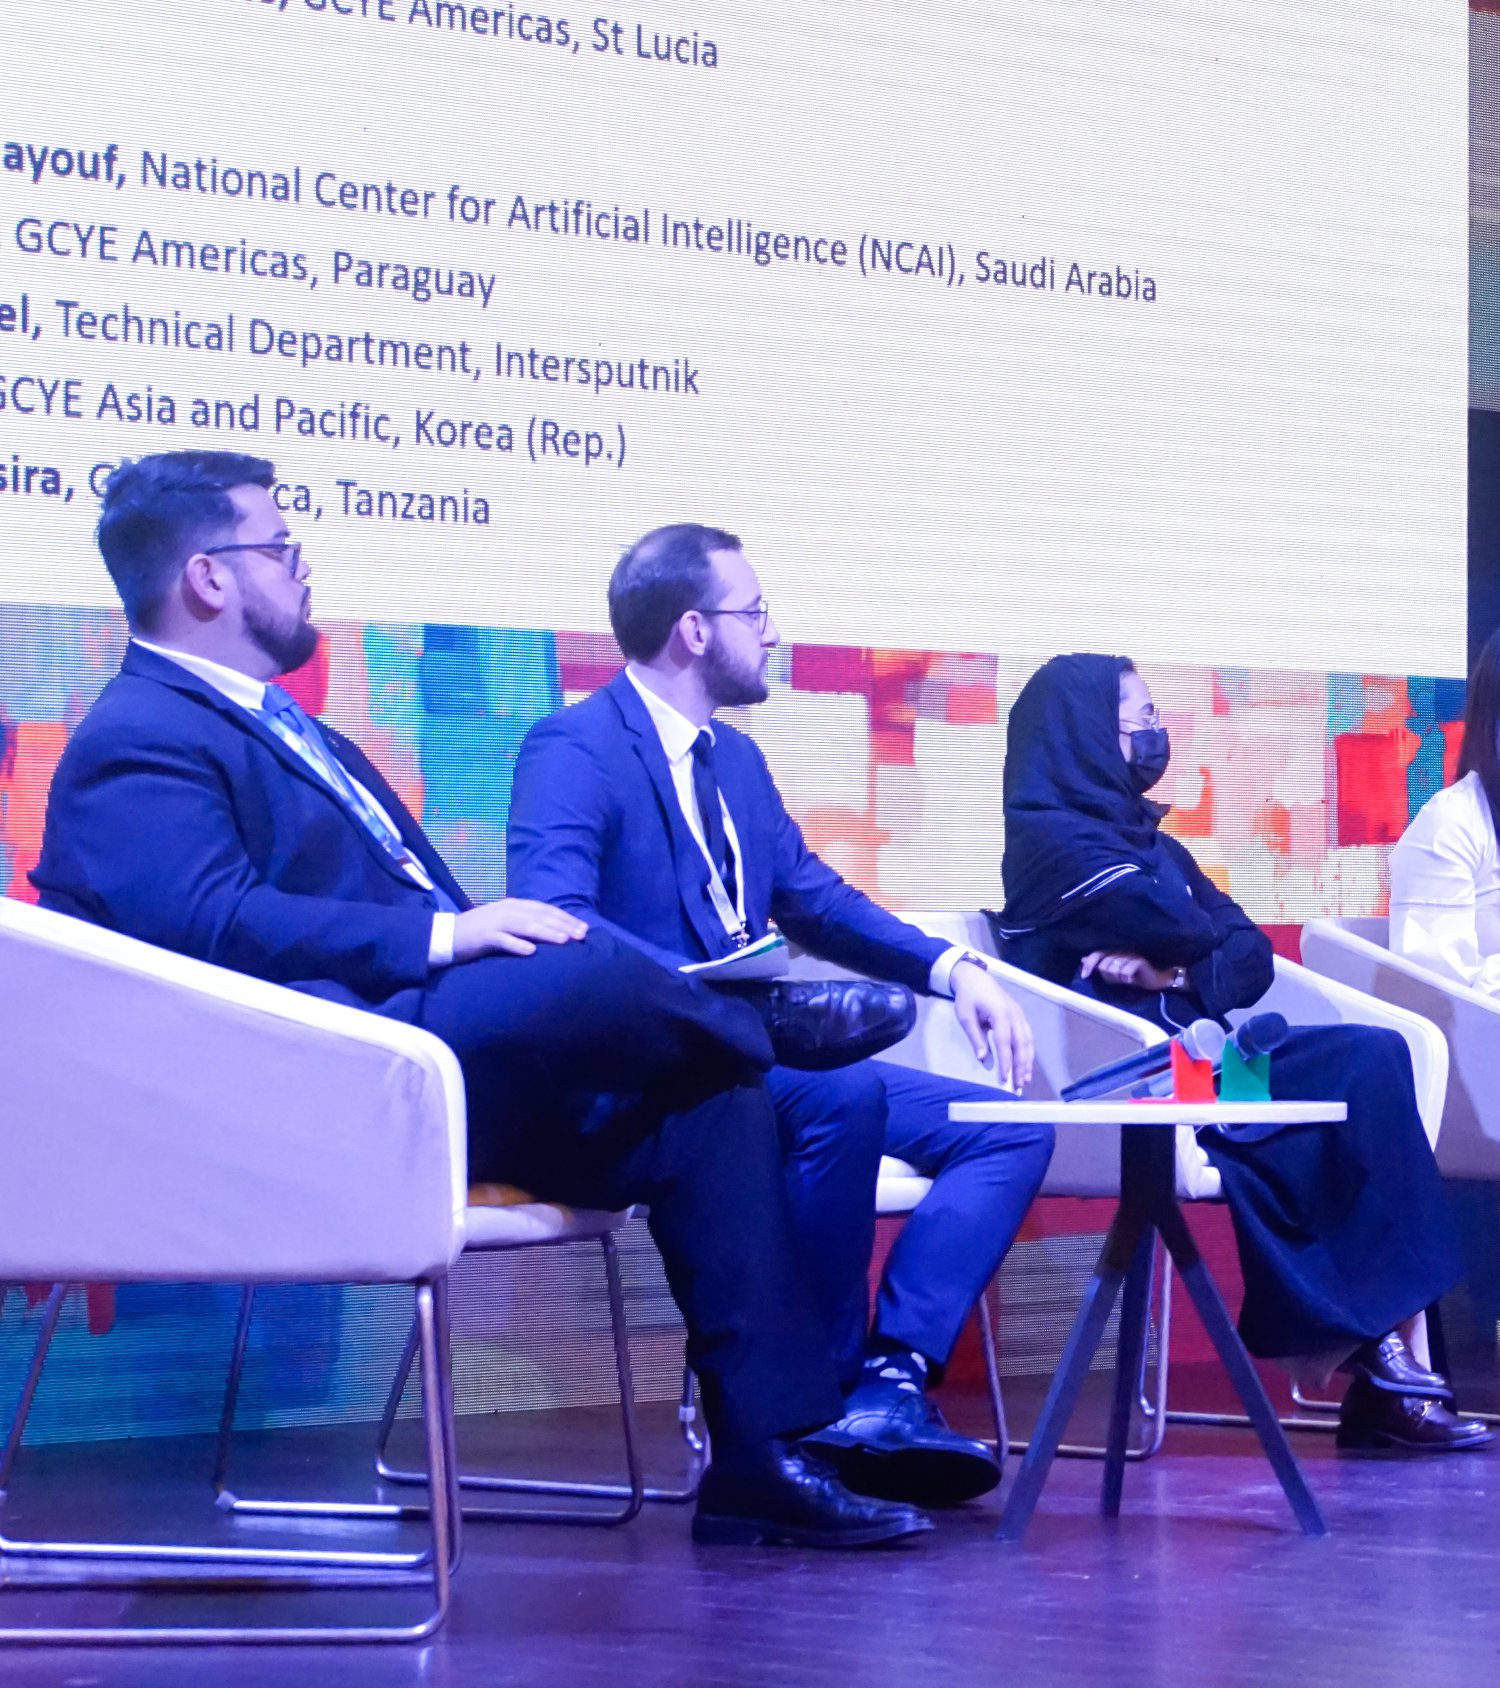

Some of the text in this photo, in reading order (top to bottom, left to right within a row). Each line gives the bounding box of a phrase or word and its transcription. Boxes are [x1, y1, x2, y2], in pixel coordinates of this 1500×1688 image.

[408, 0, 579, 53] Americas,
[592, 17, 624, 55] St
[636, 23, 718, 68] Lucia
[3, 141, 1156, 302] ayouf, National Center for Artificial Intelligence (NCAI), Saudi Arabia
[15, 217, 496, 309] GCYE Americas, Paraguay
[55, 299, 235, 352] Technical
[249, 317, 482, 383] Department,
[496, 341, 699, 395] Intersputnik
[0, 374, 626, 469] CYE Asia and Pacific, Korea (Rep.)
[336, 478, 490, 525] Tanzania
